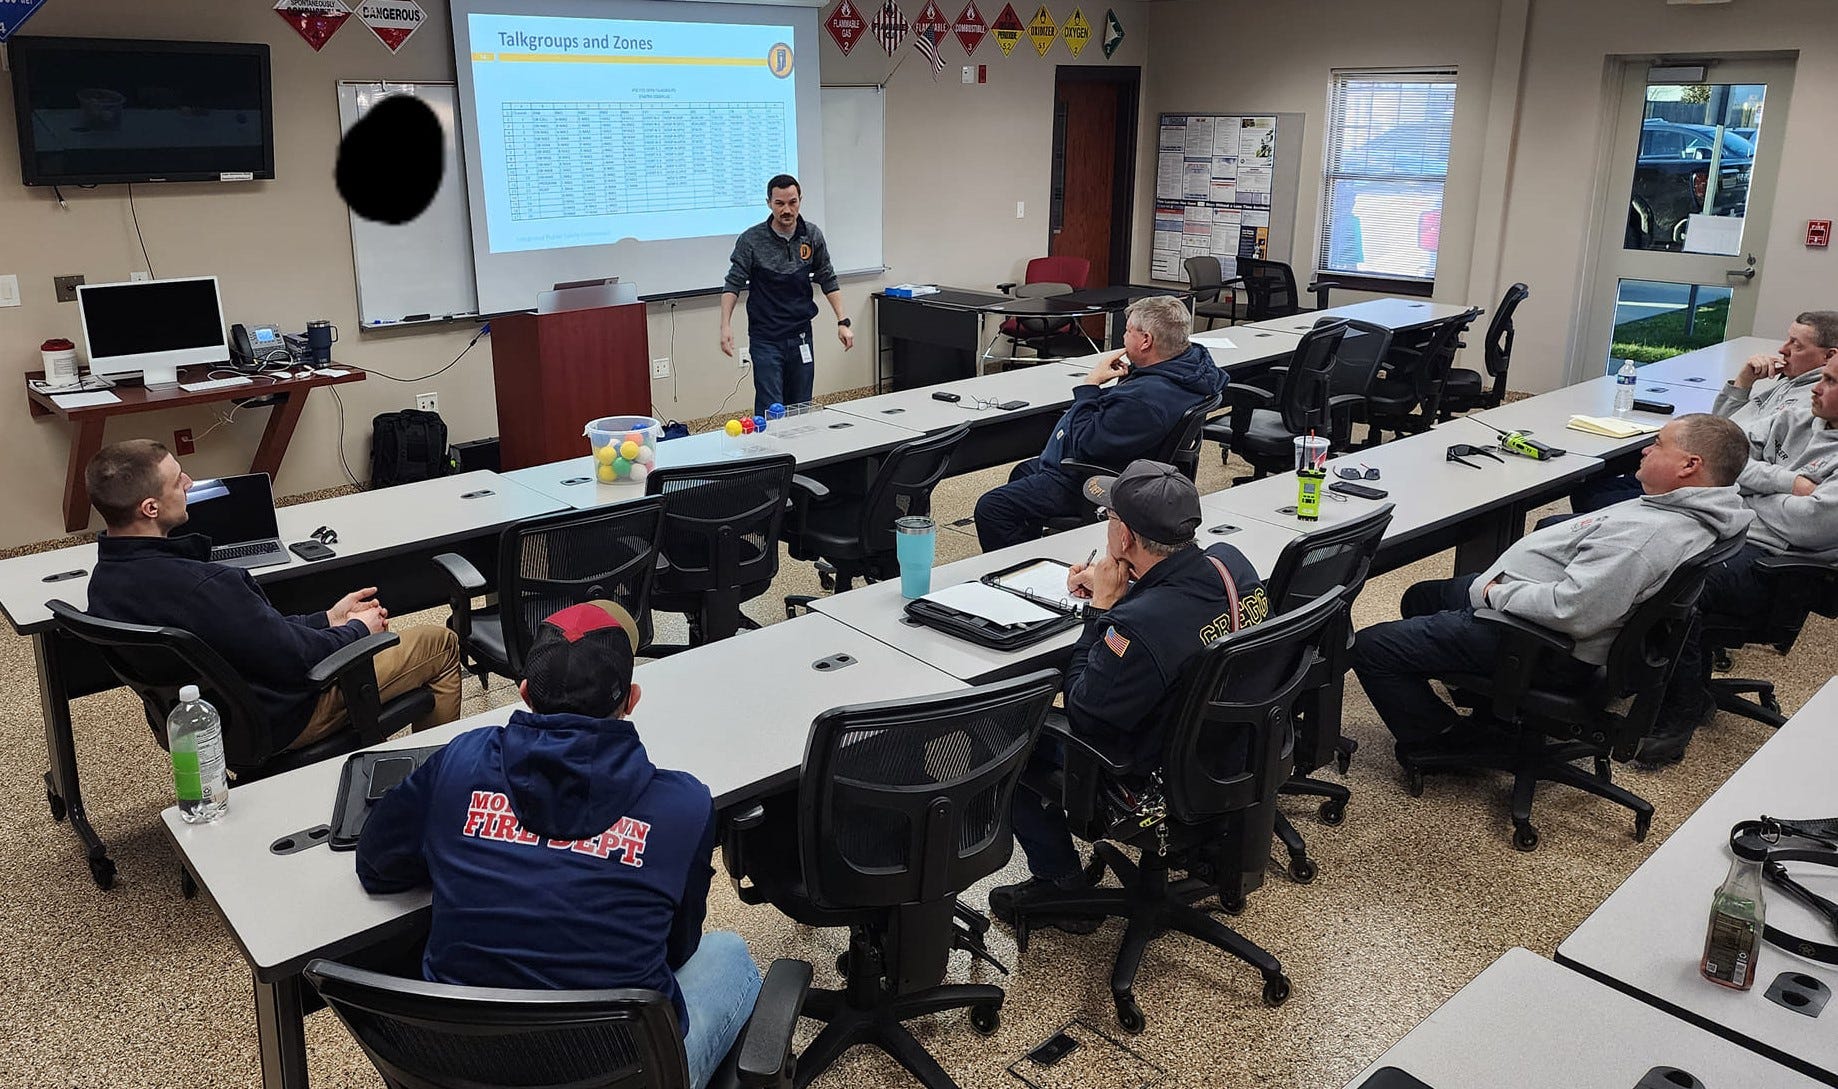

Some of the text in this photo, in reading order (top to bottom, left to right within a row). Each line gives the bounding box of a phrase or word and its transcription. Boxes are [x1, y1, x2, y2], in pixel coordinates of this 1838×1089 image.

[362, 6, 421, 22] DANGEROUS
[833, 19, 860, 29] FLAMMABLE
[841, 29, 852, 38] GAS
[1064, 26, 1089, 38] OXYGEN
[498, 31, 653, 51] Talkgroups and Zones
[844, 41, 849, 51] 2
[547, 831, 646, 867] EPT.
